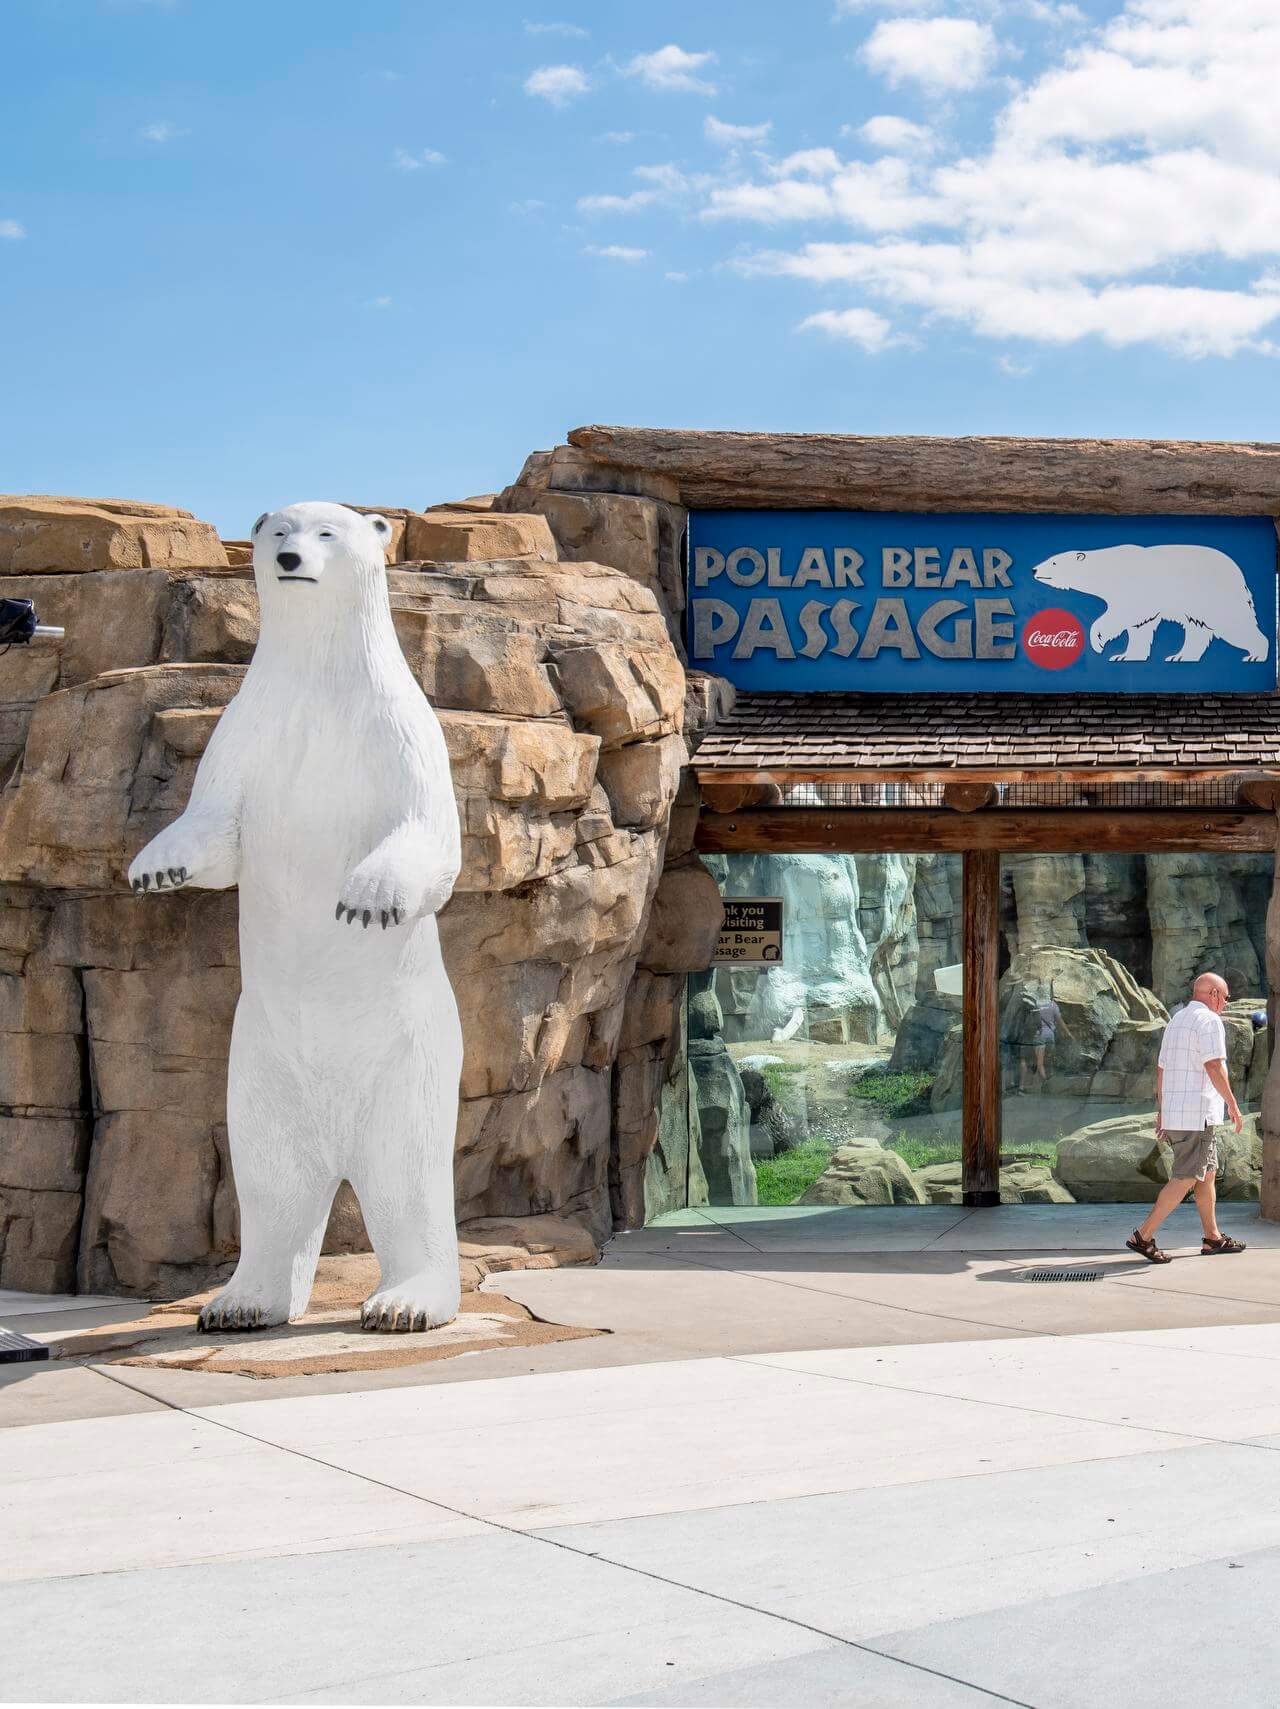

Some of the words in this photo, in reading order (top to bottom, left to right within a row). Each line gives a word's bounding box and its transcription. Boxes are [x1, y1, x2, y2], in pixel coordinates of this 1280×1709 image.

[694, 546, 865, 588] POLAR
[882, 546, 1014, 588] BEAR
[692, 597, 1017, 660] PASSAGE
[1028, 630, 1080, 648] Coca-Cola
[742, 907, 764, 917] you
[735, 934, 764, 944] Bear
[715, 948, 746, 958] ssage
